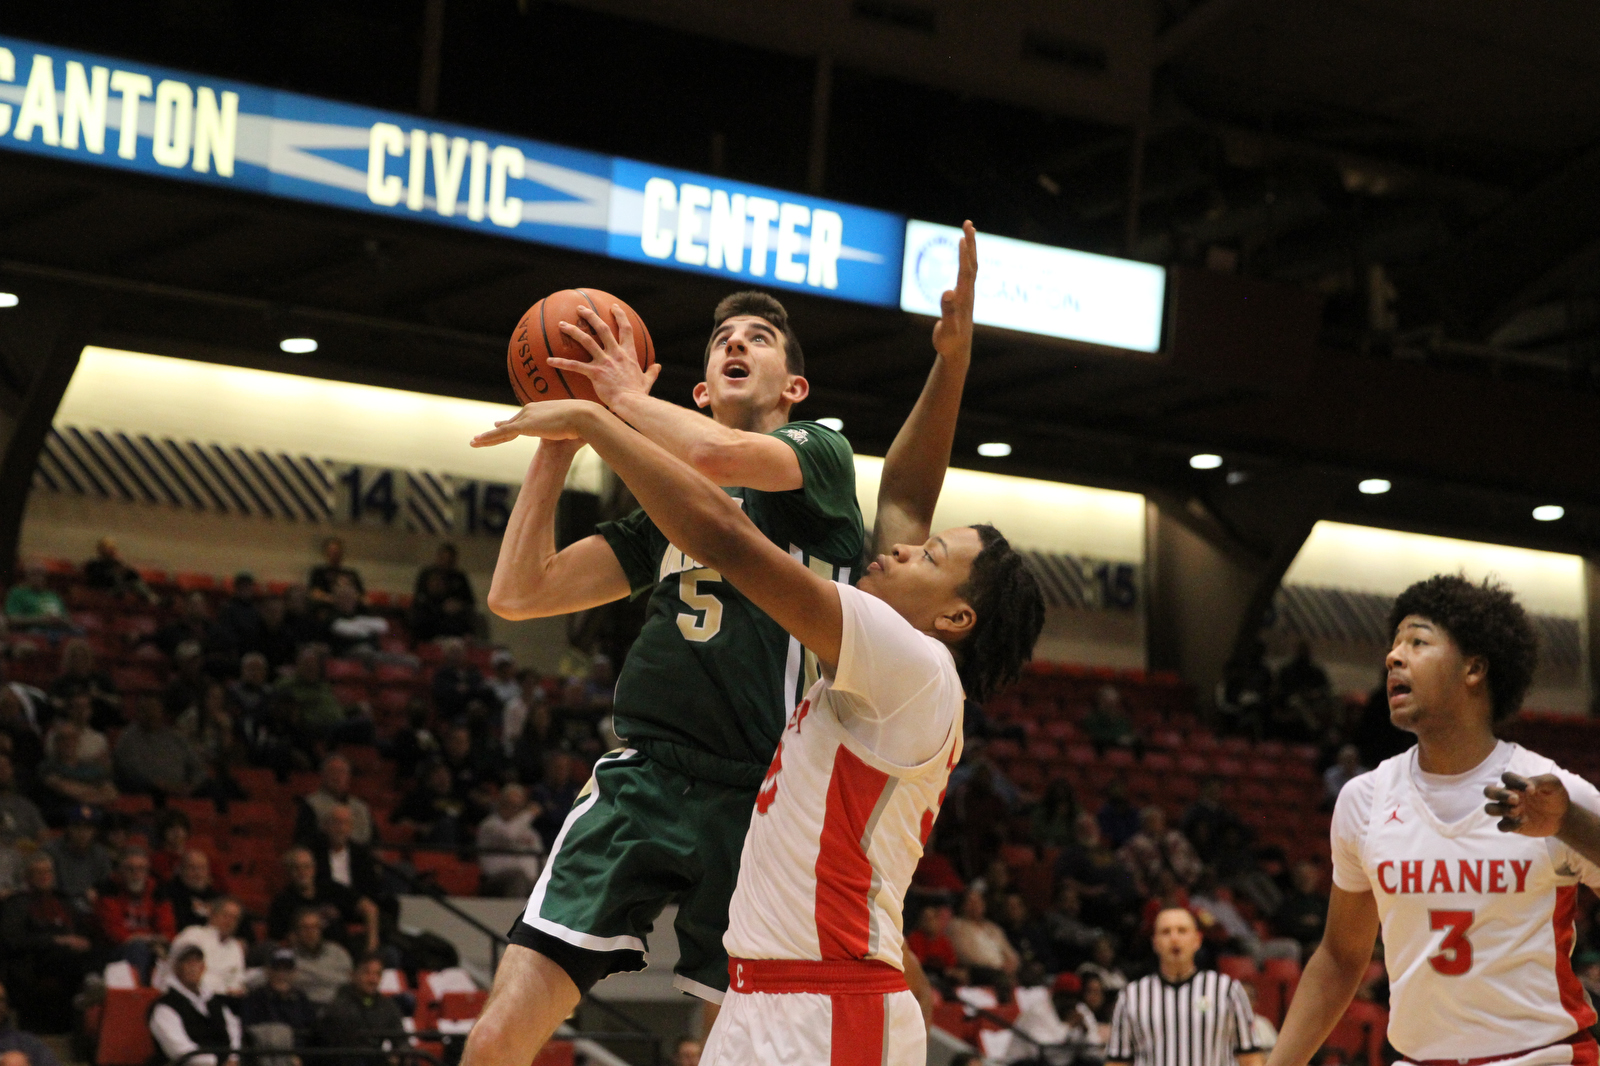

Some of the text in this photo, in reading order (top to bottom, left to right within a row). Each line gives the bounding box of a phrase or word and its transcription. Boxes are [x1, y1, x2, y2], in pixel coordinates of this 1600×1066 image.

[366, 121, 526, 229] CIVIC
[640, 176, 843, 290] CENTER
[339, 465, 397, 523] 14
[458, 479, 509, 535] 15
[676, 567, 724, 643] 5
[1095, 563, 1137, 611] 15
[1376, 858, 1534, 895] CHANEY
[1426, 907, 1476, 977] 3
